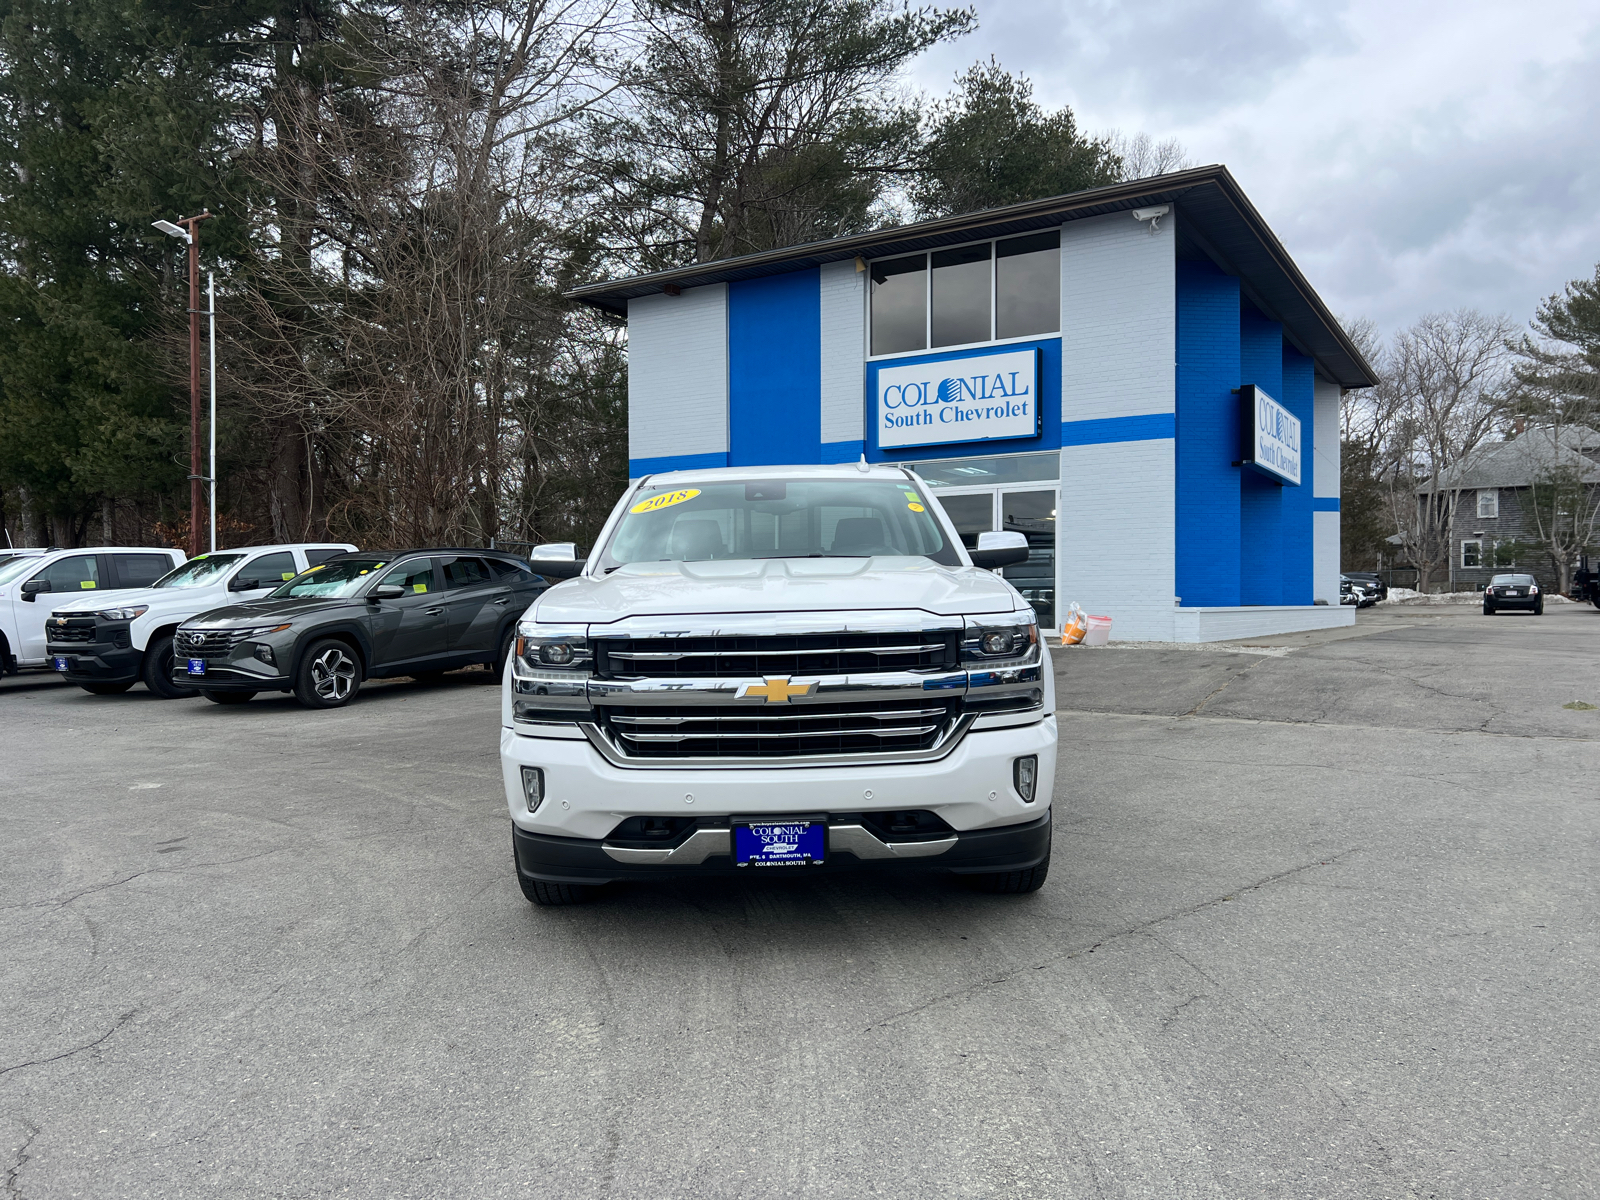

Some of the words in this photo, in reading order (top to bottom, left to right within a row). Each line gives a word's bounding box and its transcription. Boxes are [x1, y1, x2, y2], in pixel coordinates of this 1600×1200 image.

[884, 372, 1029, 409] COLONIAL
[885, 409, 933, 429] South
[939, 401, 1029, 423] Chevrolet
[1259, 397, 1298, 453] COLONIAL
[1260, 435, 1275, 465] South
[1276, 446, 1298, 478] Chevrolet
[643, 490, 688, 511] 2018
[752, 826, 807, 836] COLONIAL
[761, 835, 798, 843] SOUTH
